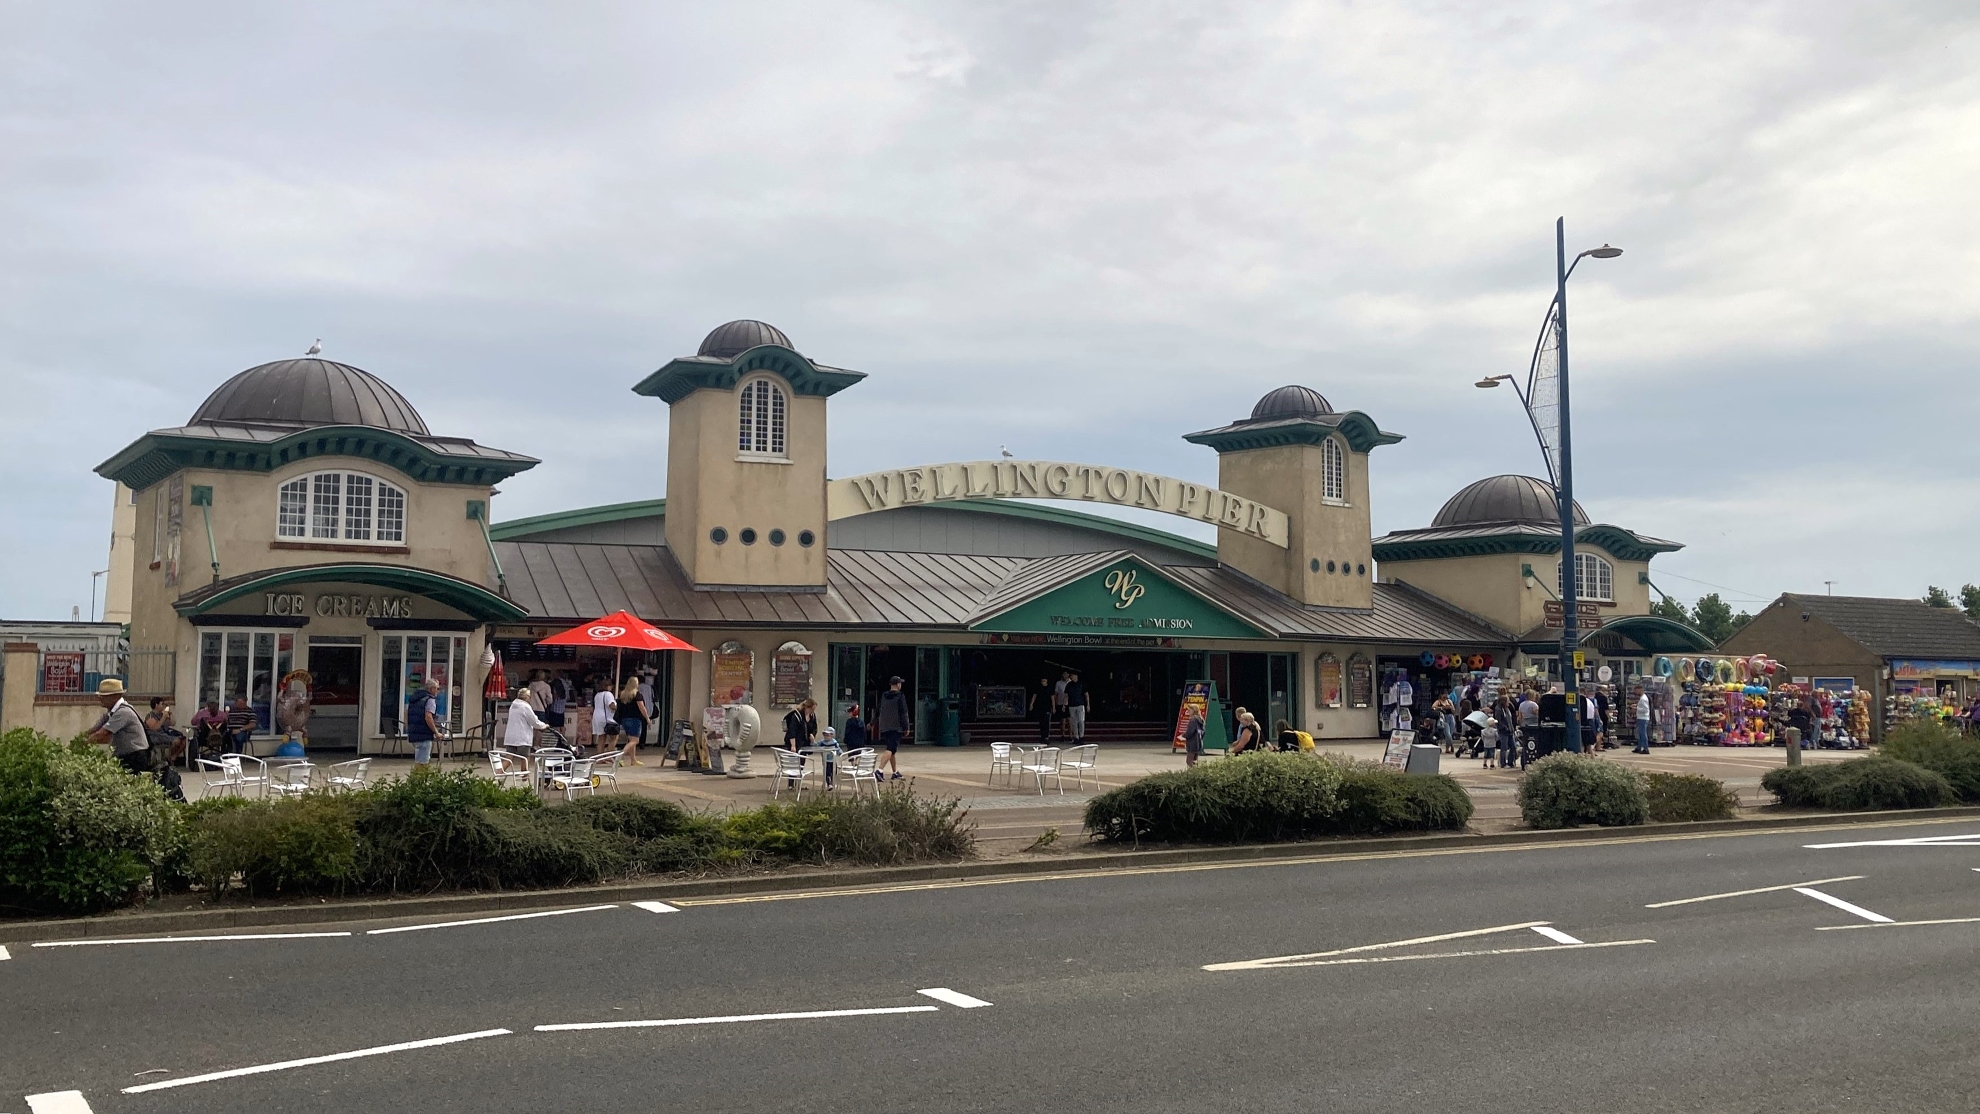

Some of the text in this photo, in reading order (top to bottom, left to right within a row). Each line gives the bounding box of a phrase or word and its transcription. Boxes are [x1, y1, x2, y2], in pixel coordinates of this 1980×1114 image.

[853, 462, 1270, 538] WELLINGTON PIER
[266, 593, 413, 618] ICE CREAMS
[1050, 615, 1193, 629] WELCOME FREE ADMISSION
[1046, 635, 1083, 645] Wellington
[1084, 635, 1102, 644] Bowl
